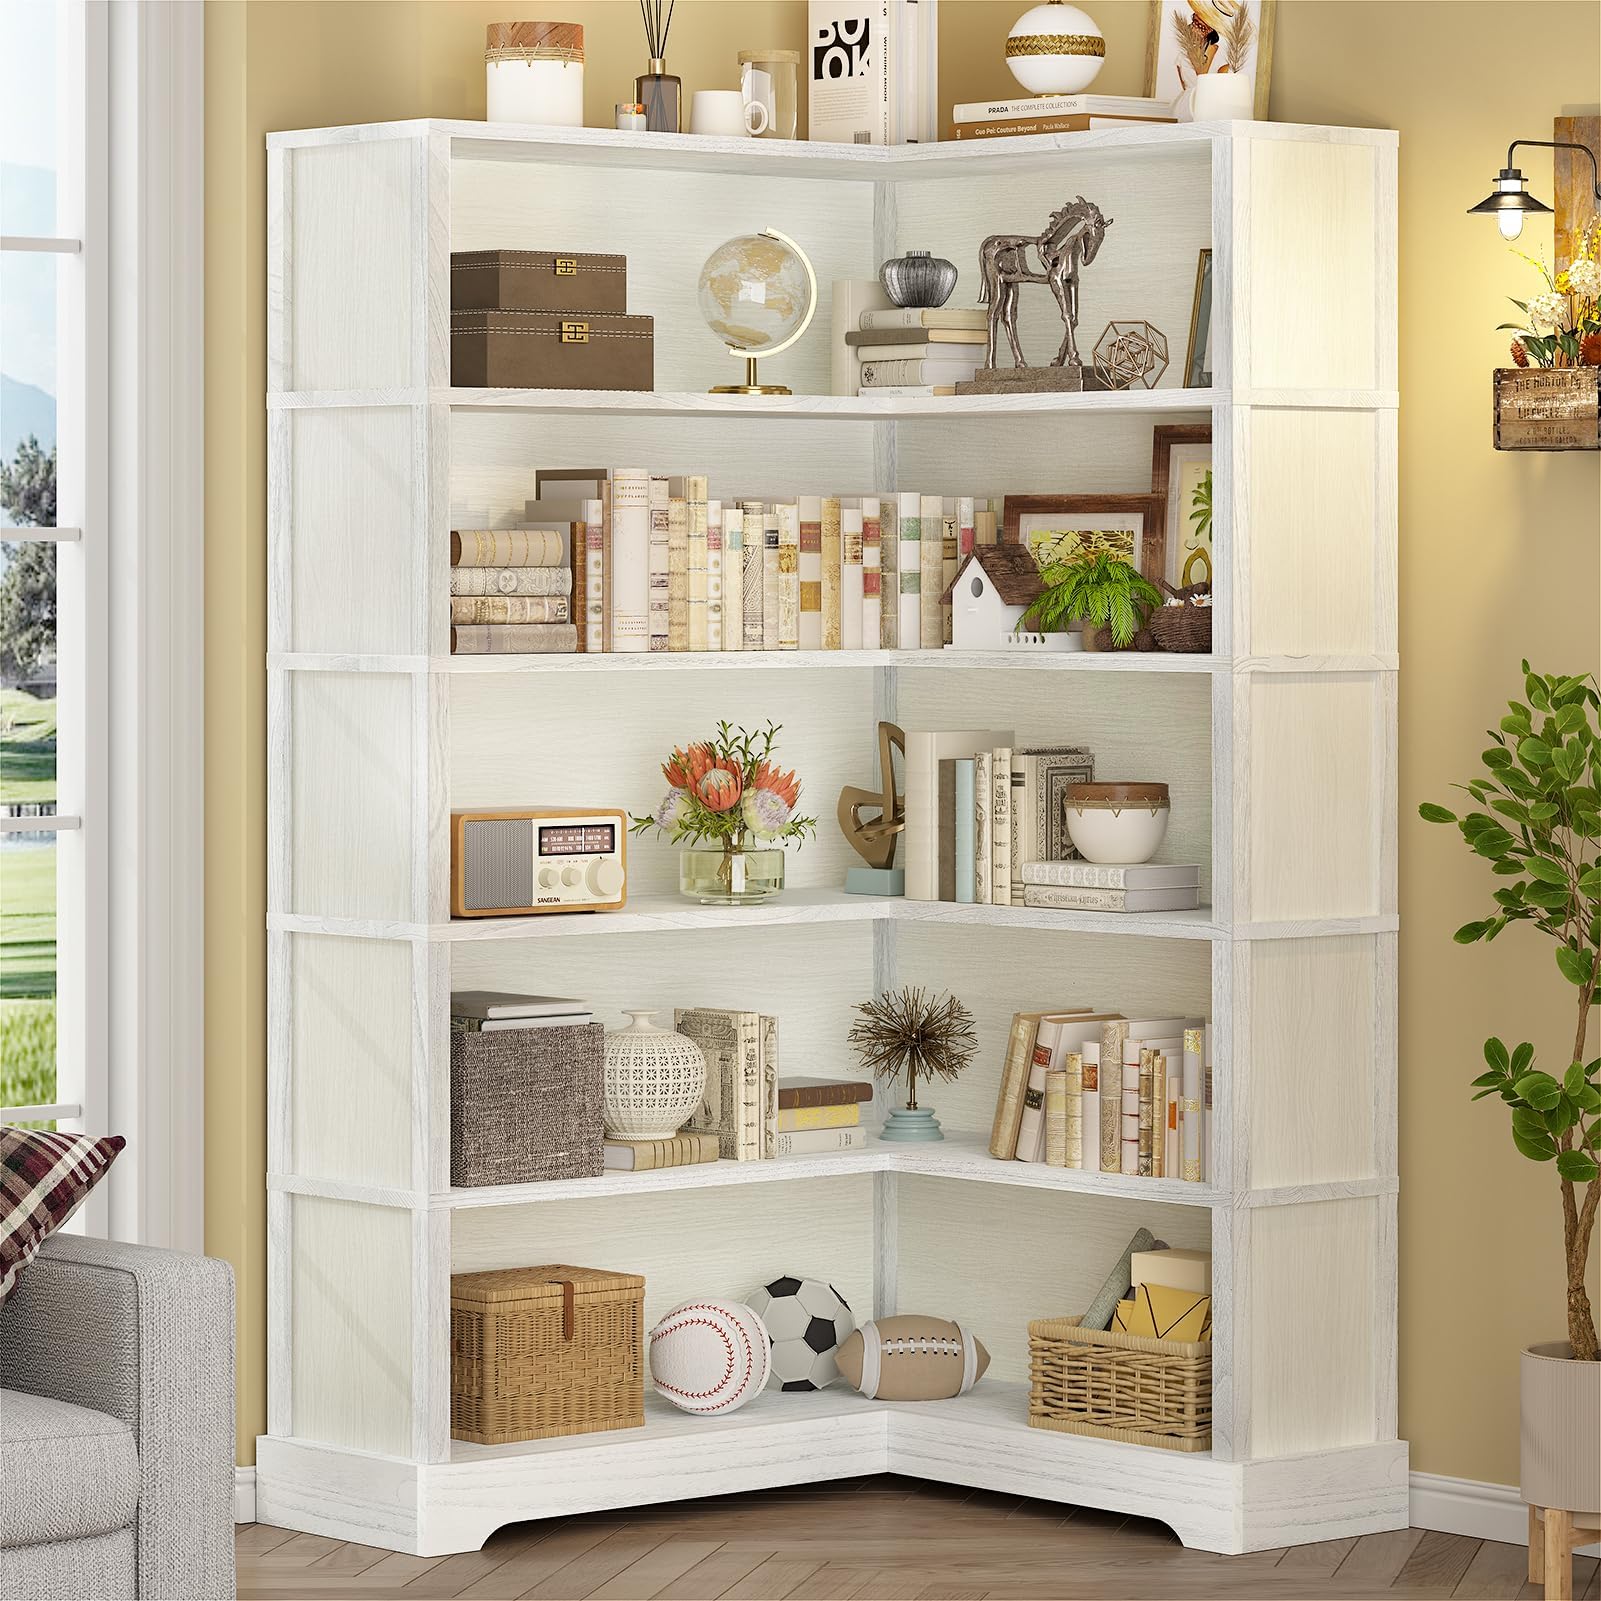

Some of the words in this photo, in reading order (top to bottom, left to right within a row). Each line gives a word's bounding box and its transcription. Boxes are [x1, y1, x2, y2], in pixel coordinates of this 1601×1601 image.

[988, 106, 1009, 114] PRADA
[1020, 103, 1045, 111] COMPLETE
[1045, 101, 1078, 110] COLLECTIONS
[996, 126, 1017, 134] Couture
[1017, 124, 1038, 133] Beyond
[1042, 123, 1054, 131] Paula
[1515, 379, 1530, 392] THE
